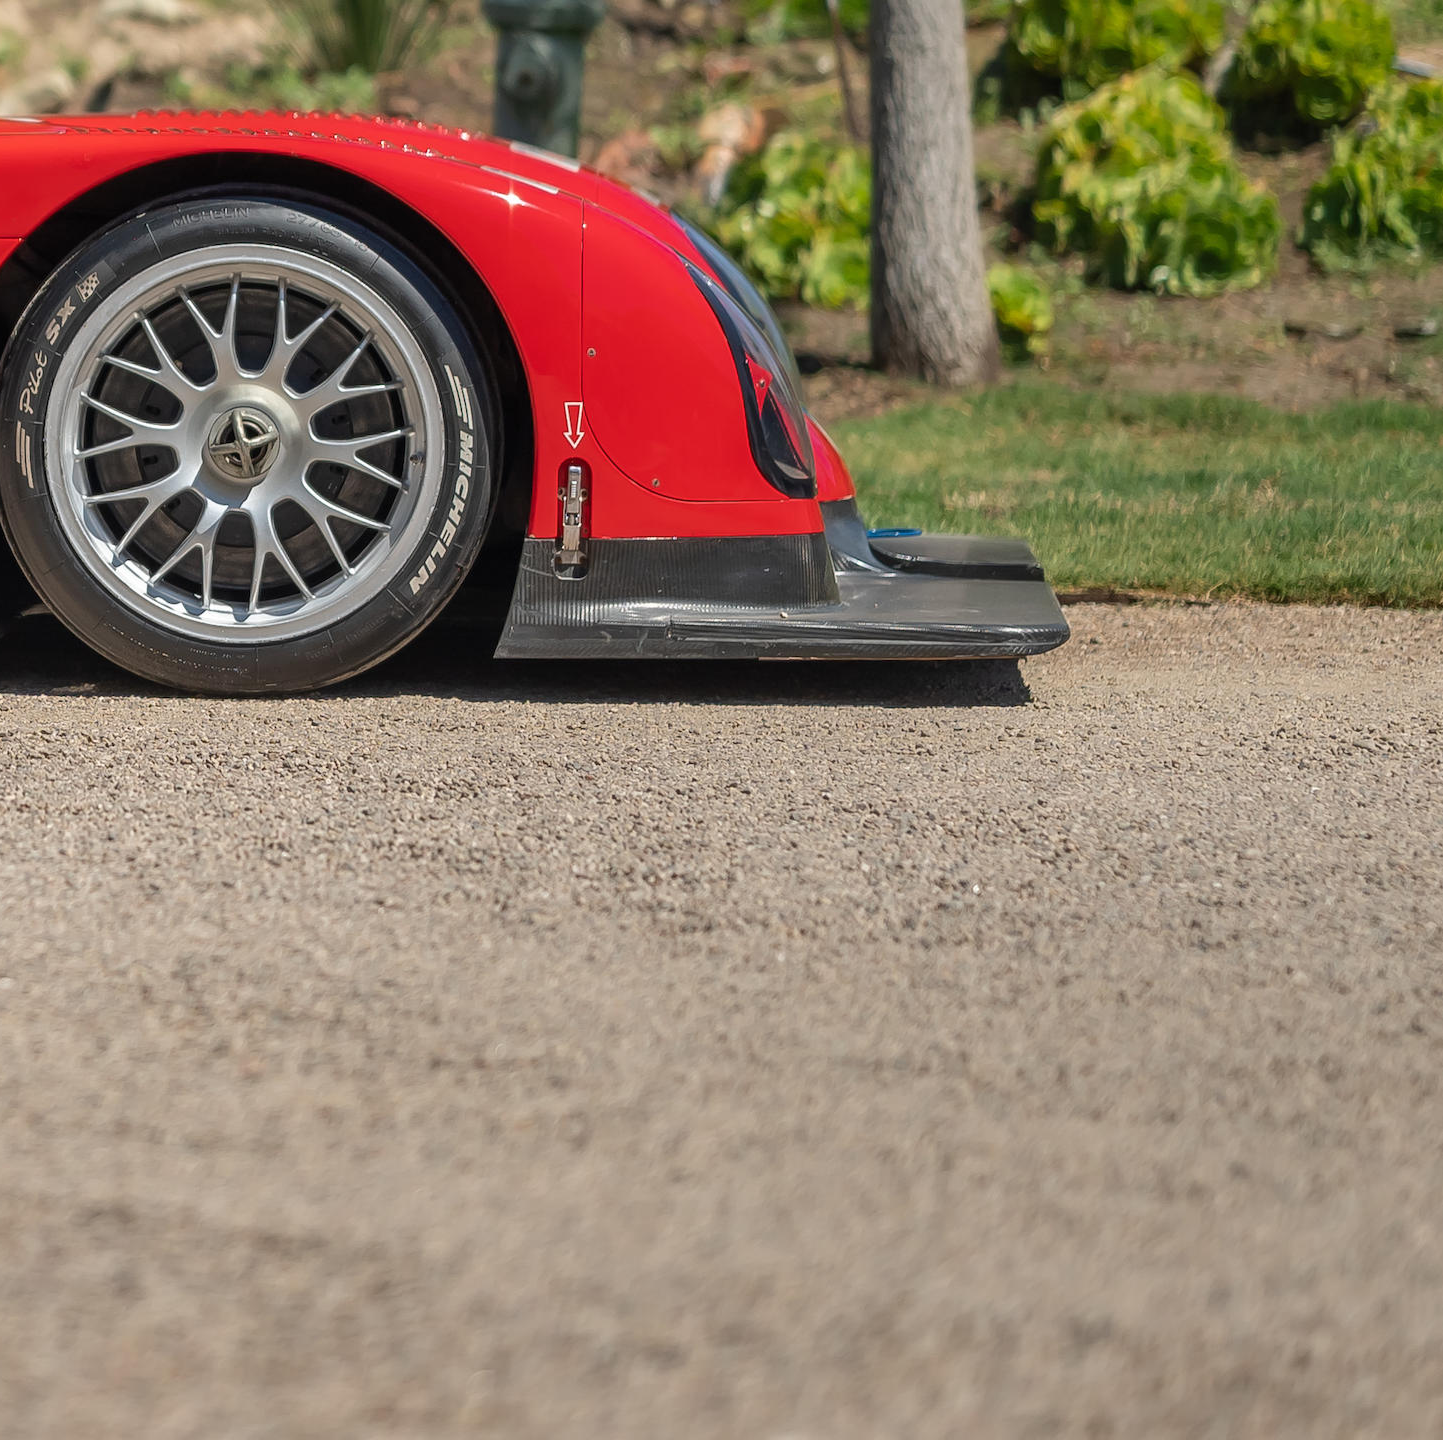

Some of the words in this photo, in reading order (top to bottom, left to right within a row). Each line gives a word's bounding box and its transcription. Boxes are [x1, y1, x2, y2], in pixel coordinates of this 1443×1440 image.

[19, 349, 48, 415] Pilot
[45, 296, 76, 346] SX
[409, 430, 474, 596] MICHELIN
